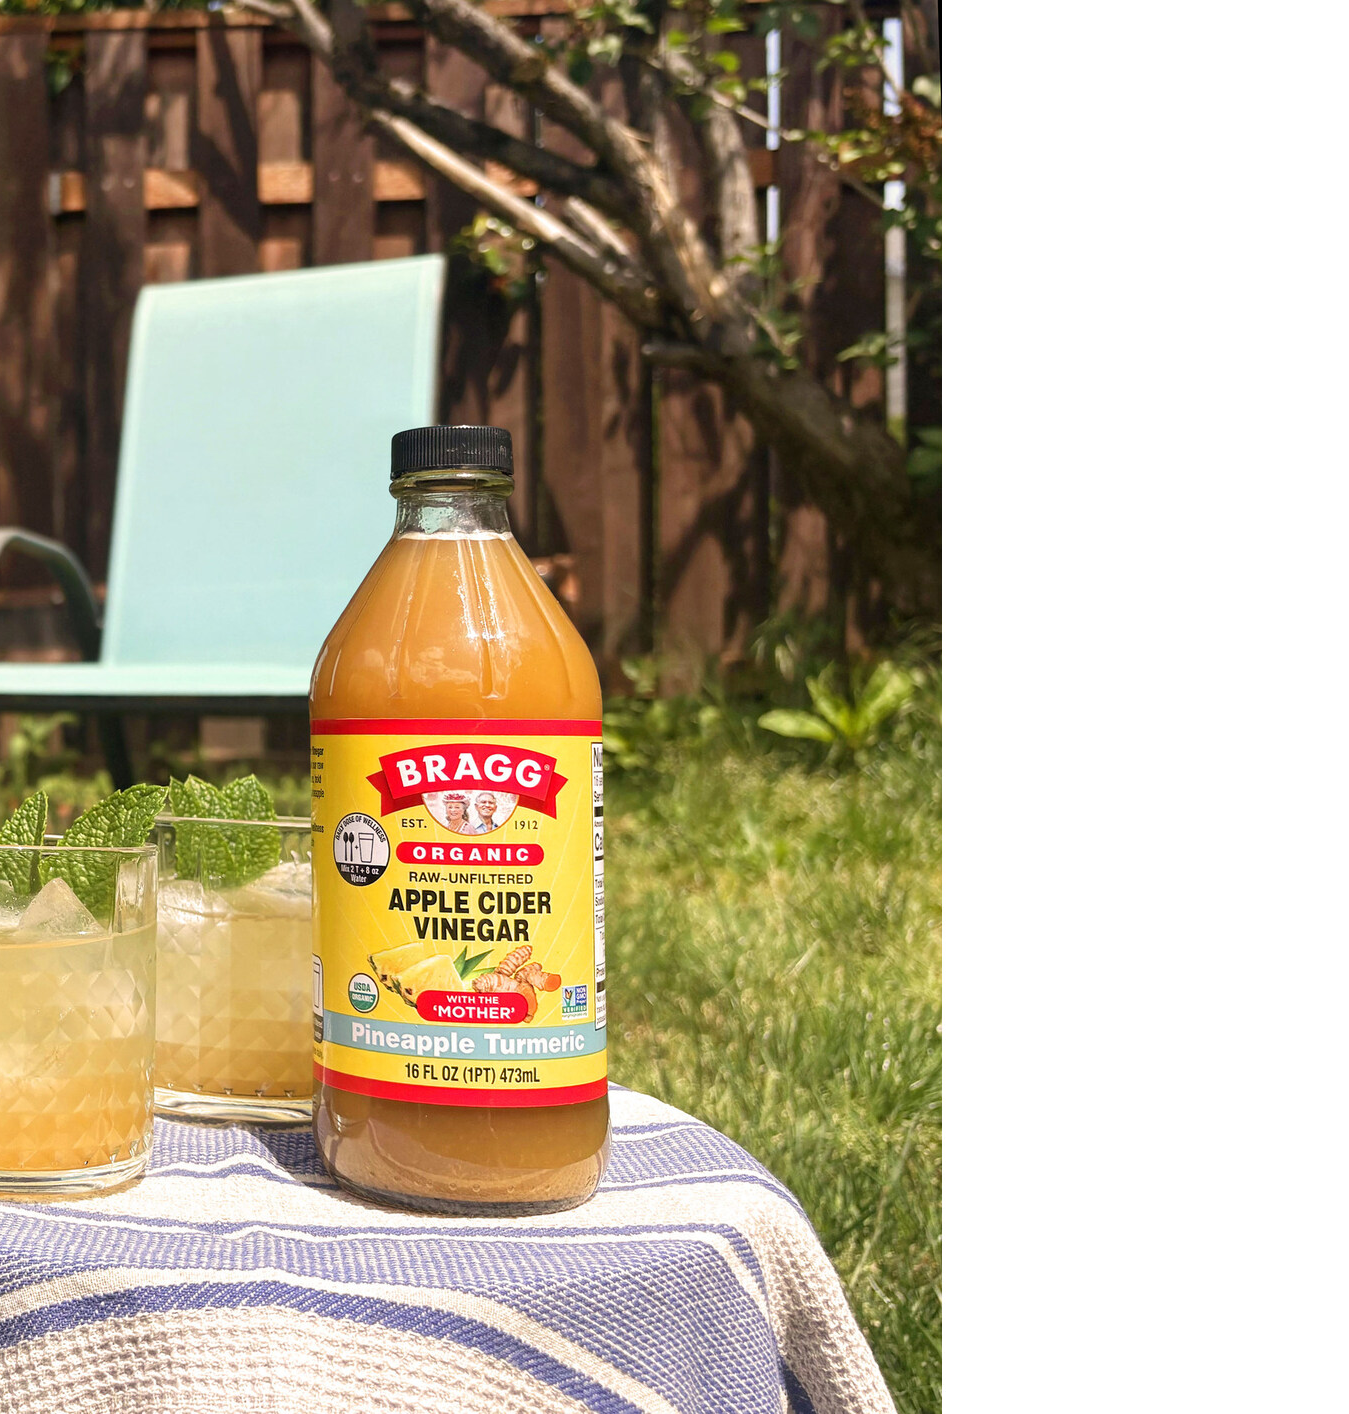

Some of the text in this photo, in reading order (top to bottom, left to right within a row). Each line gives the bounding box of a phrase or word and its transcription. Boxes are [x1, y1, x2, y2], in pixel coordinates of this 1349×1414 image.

[396, 753, 542, 788] BRAGG
[343, 815, 355, 828] DOSE
[362, 816, 387, 843] WELLNESS
[401, 818, 427, 829] EST.
[514, 820, 538, 830] 1912
[412, 846, 530, 862] ORGANIC
[340, 864, 350, 873] Mix
[350, 865, 355, 873] 2
[365, 866, 370, 875] 8
[350, 873, 367, 883] Water
[388, 888, 551, 915] APPLE CIDER
[413, 916, 530, 942] VINEGAR
[353, 981, 371, 992] USDA
[351, 993, 373, 1003] ORGANIC
[446, 995, 499, 1005] WITH THE
[351, 1021, 475, 1058] Pineapple
[483, 1030, 585, 1055] Turmeric
[404, 1062, 540, 1084] 16 FL OZ (1PT) 473mL
